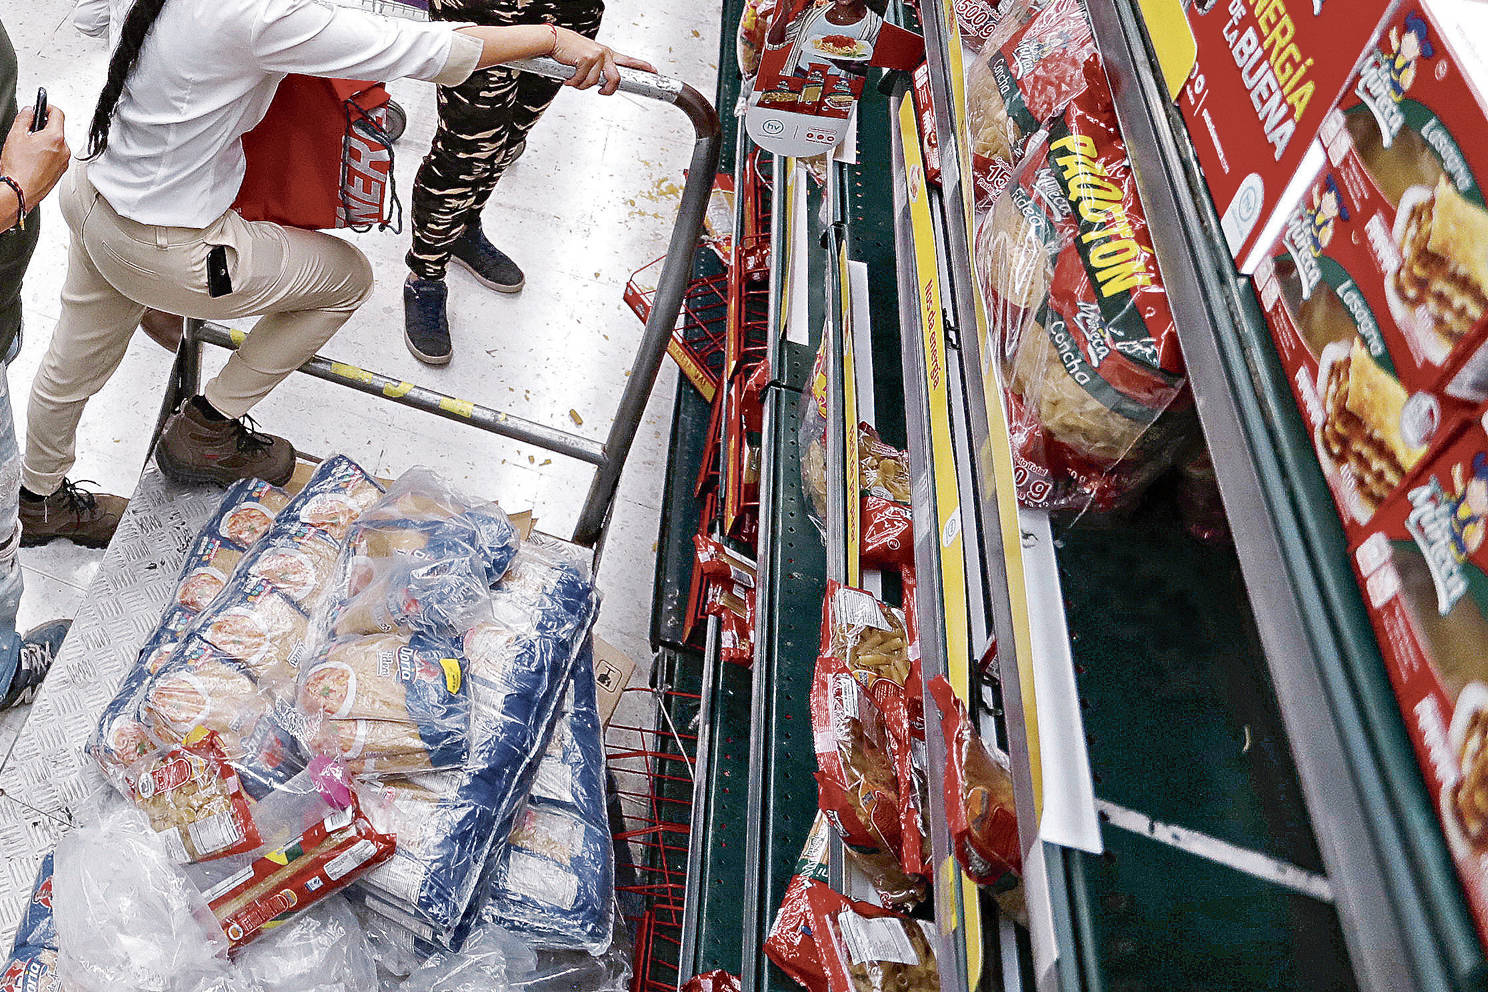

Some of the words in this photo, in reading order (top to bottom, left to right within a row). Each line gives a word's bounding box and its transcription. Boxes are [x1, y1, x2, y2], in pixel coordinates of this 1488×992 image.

[1222, 22, 1240, 52] LA
[1232, 25, 1298, 163] BUENA
[765, 120, 782, 132] hv
[922, 276, 935, 306] Nos
[1336, 279, 1383, 357] Lasagna
[925, 330, 943, 390] energía
[1048, 317, 1093, 387] Concha
